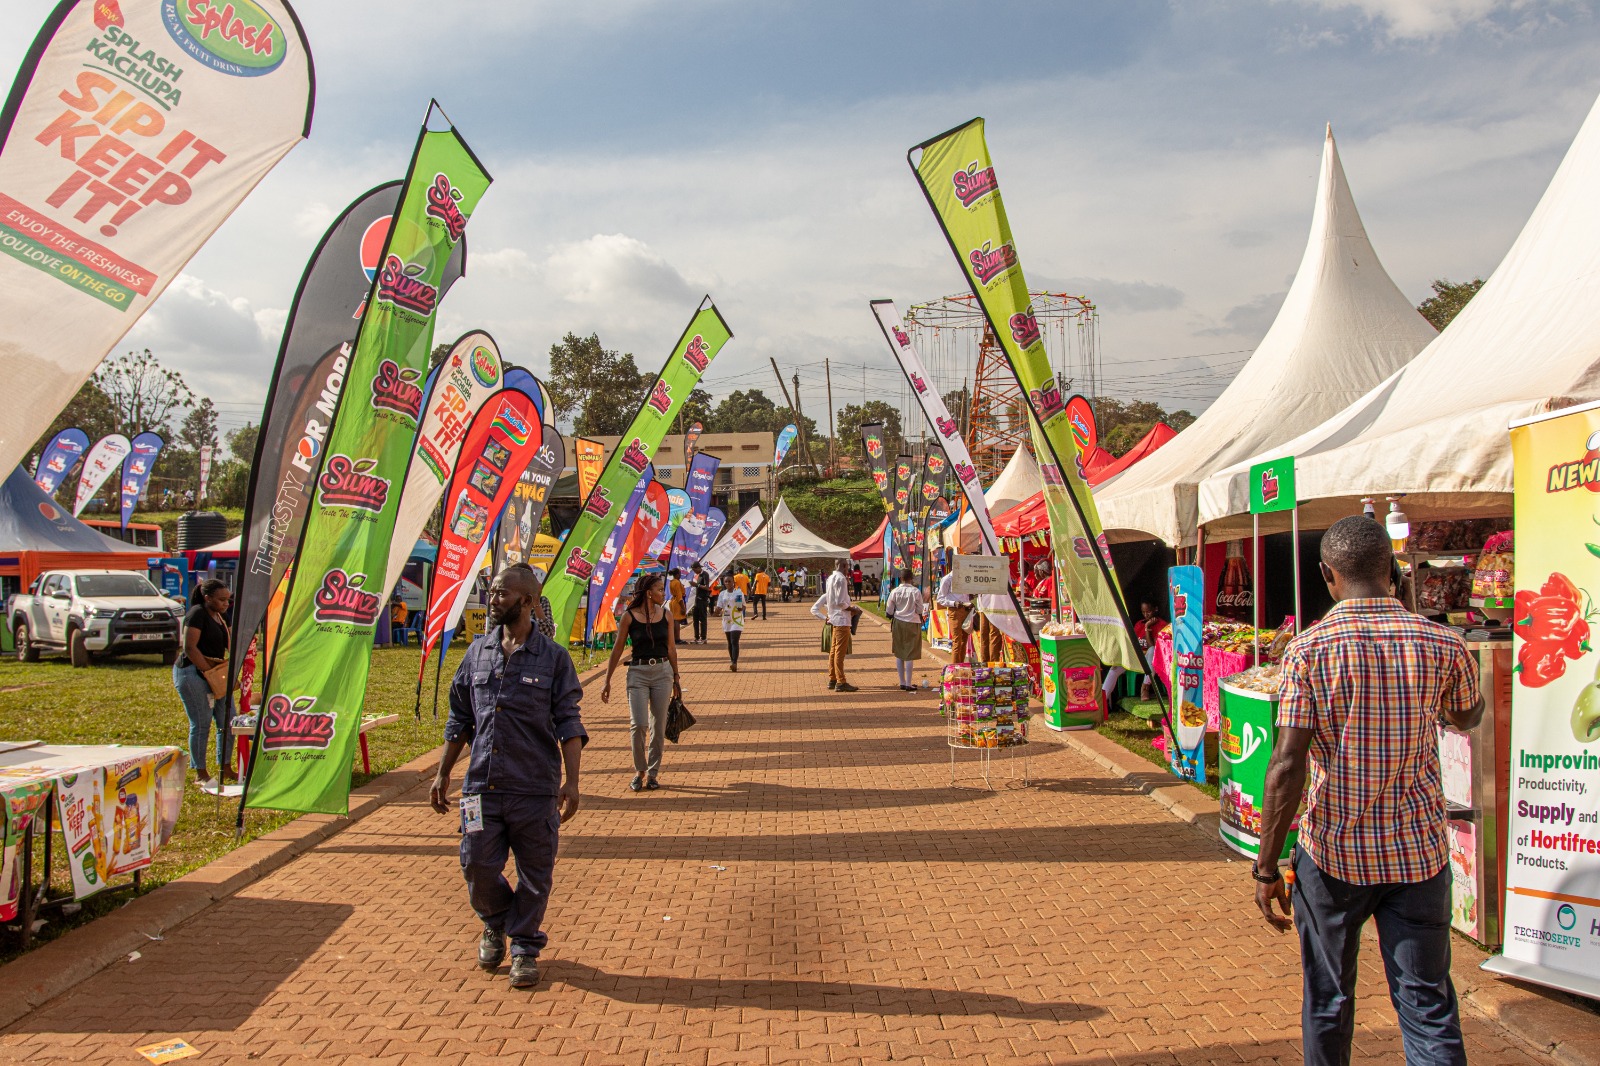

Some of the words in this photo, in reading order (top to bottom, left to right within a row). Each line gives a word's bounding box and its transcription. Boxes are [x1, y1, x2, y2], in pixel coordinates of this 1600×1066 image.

[98, 4, 119, 23] NEW
[186, 0, 274, 57] Splash
[103, 25, 184, 83] SPLASH
[165, 2, 184, 39] REAL
[183, 36, 211, 62] FRUIT
[213, 58, 244, 75] DRINK
[86, 37, 183, 107] KACHUPA
[58, 71, 166, 137] SIP
[156, 129, 227, 179] IT
[34, 109, 192, 206] KEEP
[45, 170, 143, 238] IT!
[6, 209, 54, 240] ENJOY
[49, 232, 79, 253] THE
[75, 245, 145, 288] FRESHNESS
[0, 229, 25, 252] YOU
[23, 244, 63, 272] LOVE
[59, 263, 81, 282] ON
[75, 272, 106, 297] THE
[104, 284, 127, 304] GO
[378, 254, 437, 316] Sumz
[451, 372, 472, 400] KACHUPA
[456, 367, 473, 390] SPLASH
[441, 385, 466, 413] SIP
[462, 410, 474, 425] I
[434, 428, 455, 455] IT!
[319, 454, 391, 514] Sumz
[531, 472, 551, 486] YOUR
[1547, 459, 1600, 493] NEW
[514, 482, 546, 503] SWAG
[251, 470, 306, 576] THIRSTY
[320, 506, 338, 518] Taste
[339, 509, 349, 519] The
[351, 511, 379, 524] Difference
[314, 568, 381, 625] Sumz
[1216, 590, 1253, 607] Coca-Cola
[315, 623, 334, 634] Taste
[262, 694, 336, 750] Sumz
[263, 752, 278, 762] Taste
[281, 752, 292, 761] The
[294, 752, 326, 762] Difference
[1520, 749, 1600, 773] Improvin
[1518, 777, 1587, 795] Productivity,
[1518, 800, 1575, 826] Supply
[1578, 811, 1598, 823] and
[1517, 834, 1529, 846] of
[1517, 853, 1568, 871] Products.
[1514, 926, 1581, 948] TECHNOSERVE
